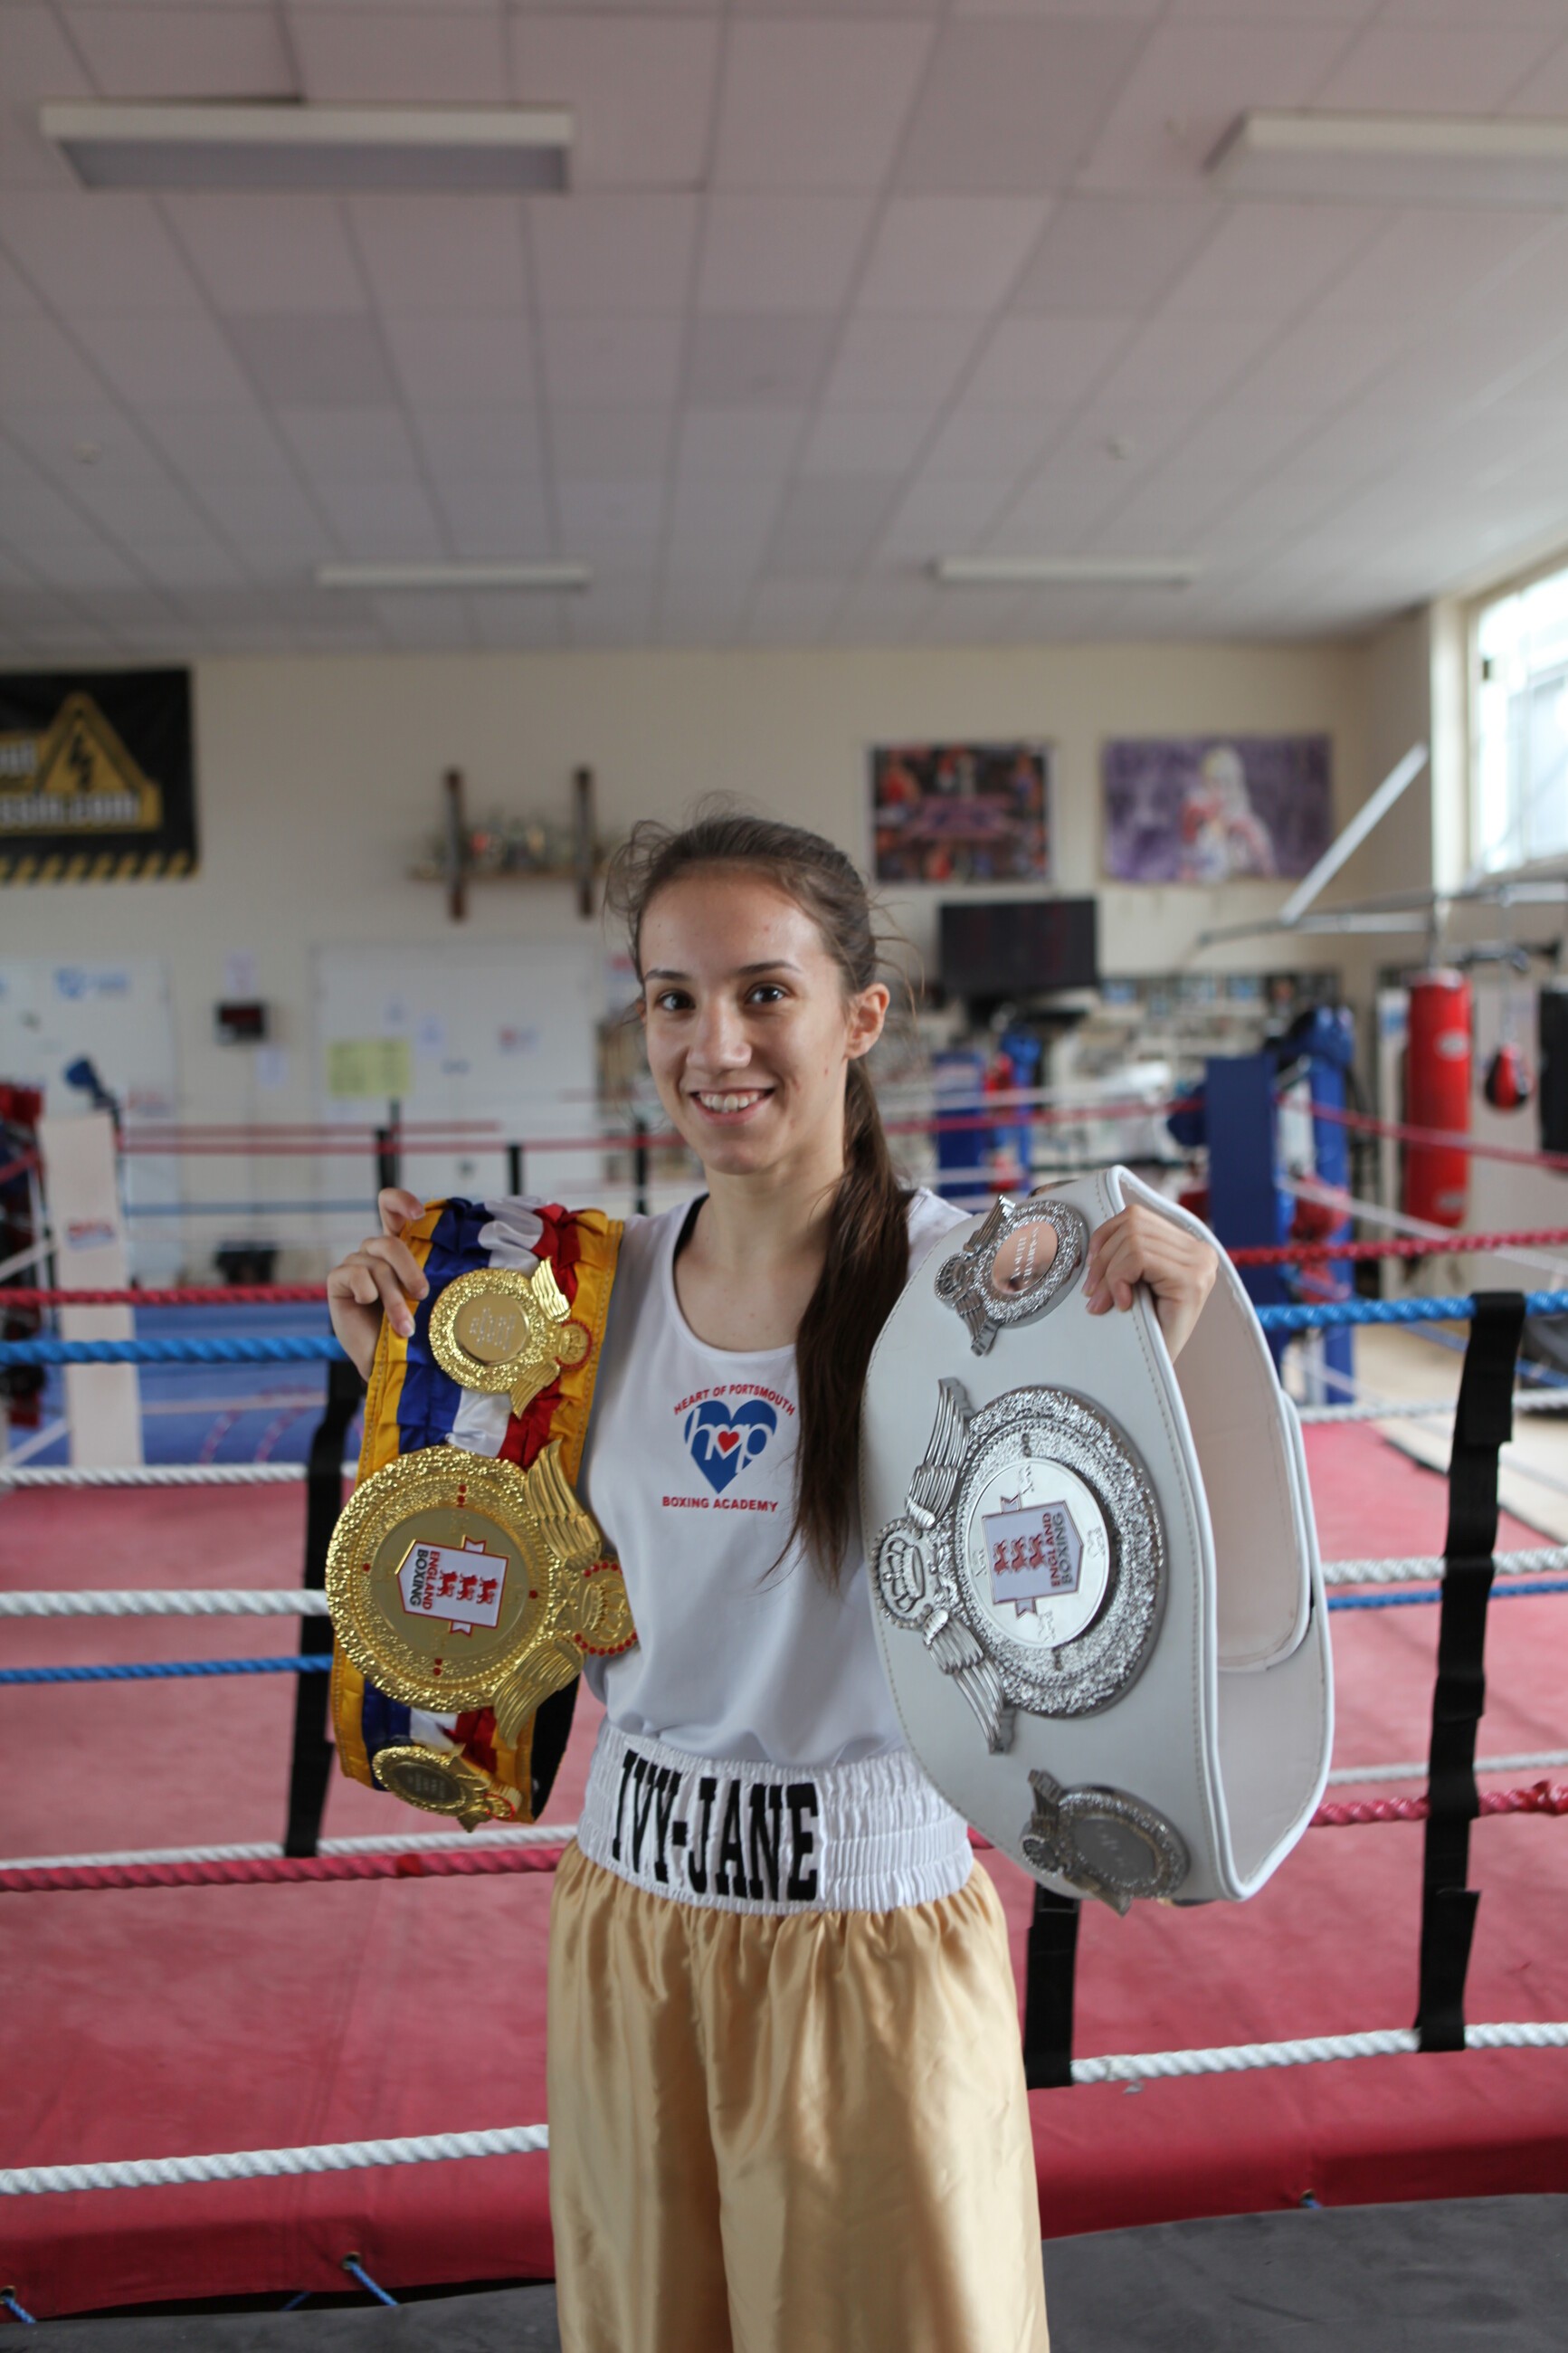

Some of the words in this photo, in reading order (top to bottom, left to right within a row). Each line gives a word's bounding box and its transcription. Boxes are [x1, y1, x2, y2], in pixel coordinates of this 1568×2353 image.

[673, 1389, 710, 1416] HEART
[712, 1386, 727, 1397] OF
[728, 1384, 796, 1417] PORTSMOUTH
[662, 1496, 709, 1510] BOXING
[713, 1498, 779, 1512] ACADEMY
[410, 1548, 429, 1607] BOXING
[1042, 1512, 1061, 1587] ENGLAND
[1052, 1512, 1073, 1584] BOXING
[422, 1549, 441, 1610] ENGLAND
[612, 1748, 820, 1902] IVY-JANE
